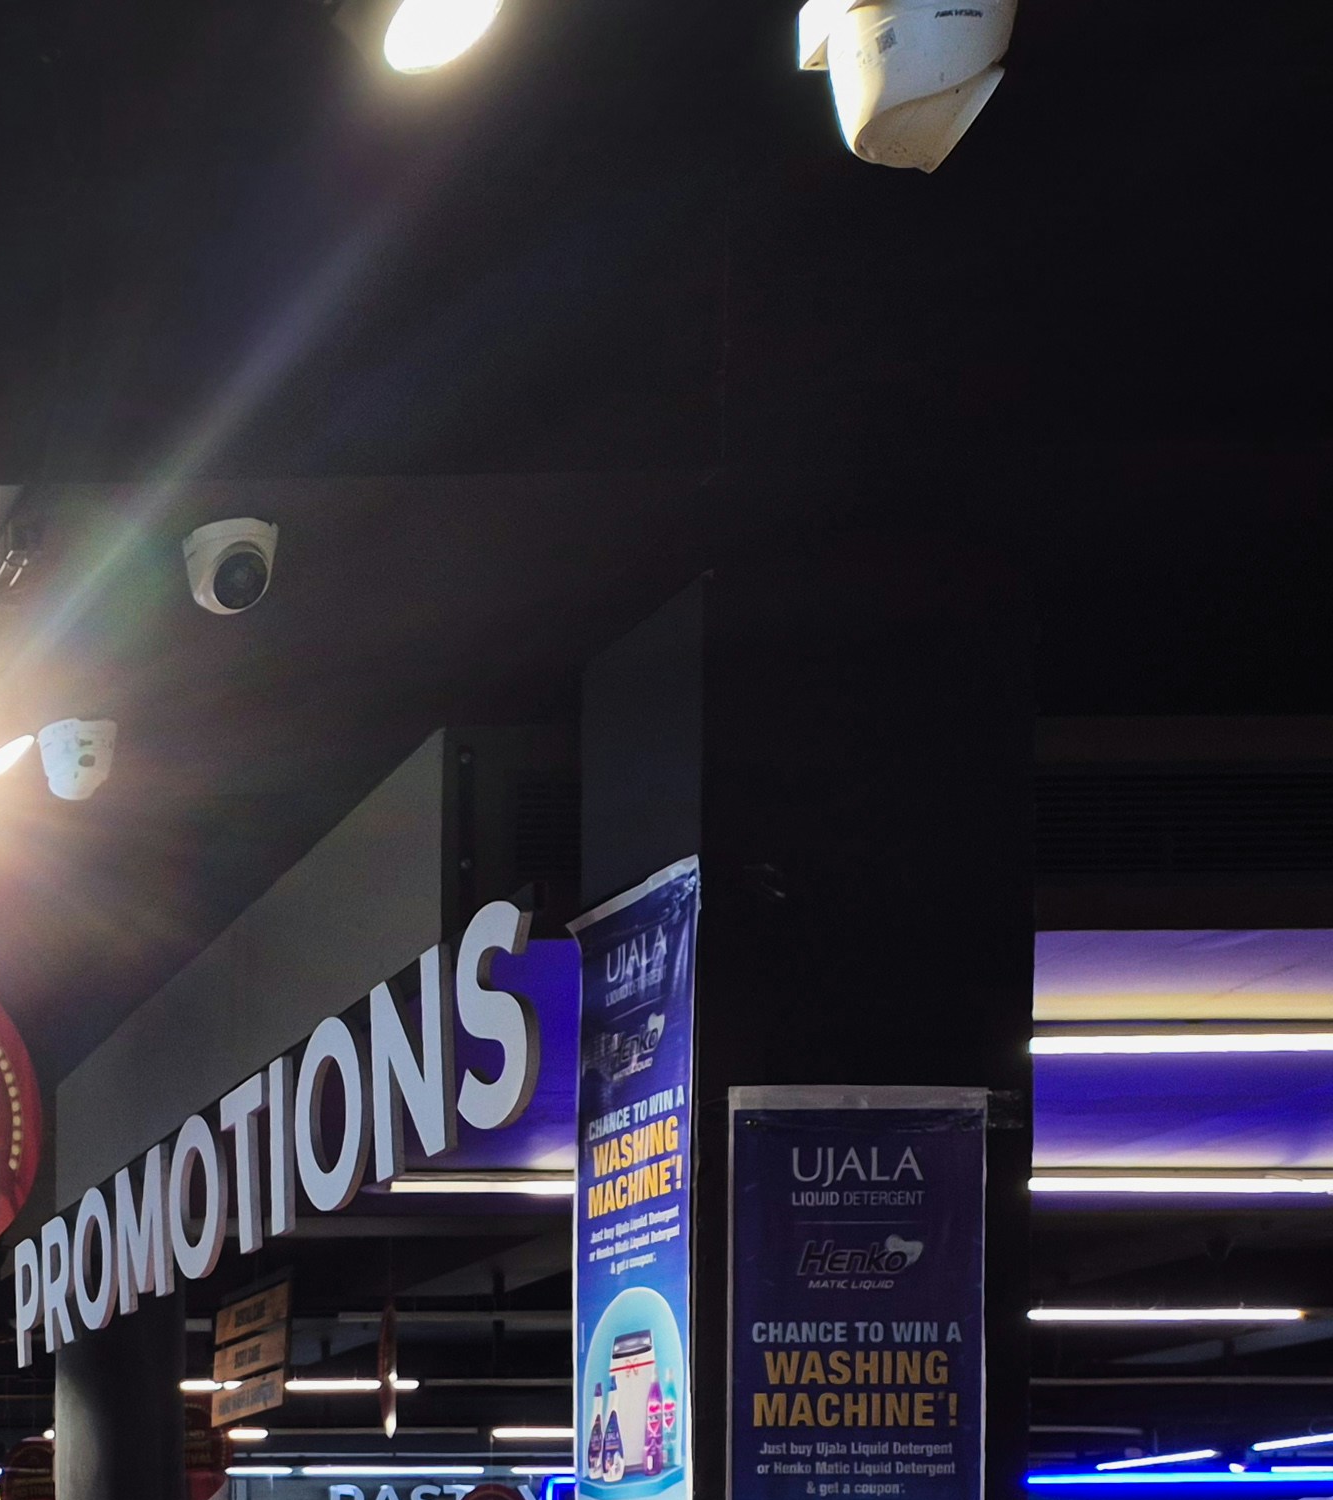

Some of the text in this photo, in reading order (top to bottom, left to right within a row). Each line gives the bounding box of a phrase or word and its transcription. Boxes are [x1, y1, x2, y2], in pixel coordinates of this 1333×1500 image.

[606, 924, 668, 983] UJALA
[588, 1084, 685, 1141] CHANCE TO WIN A
[14, 899, 534, 1368] PROMOTIONS
[592, 1114, 679, 1178] WASHING
[791, 1145, 925, 1188] UJALA
[791, 1189, 925, 1207] LIQUID DETERGENT
[796, 1239, 909, 1276] Henko
[807, 1278, 894, 1291] MATIC LIQUID
[751, 1320, 963, 1344] CHANCE TO WIN A
[763, 1349, 950, 1386] WASHING
[759, 1441, 953, 1458] Just buy Ujala Liquid Detergent
[756, 1461, 956, 1478] or Henko Matic Liquid Detergent
[805, 1481, 816, 1495] &
[819, 1481, 840, 1497] get
[842, 1484, 851, 1495] a
